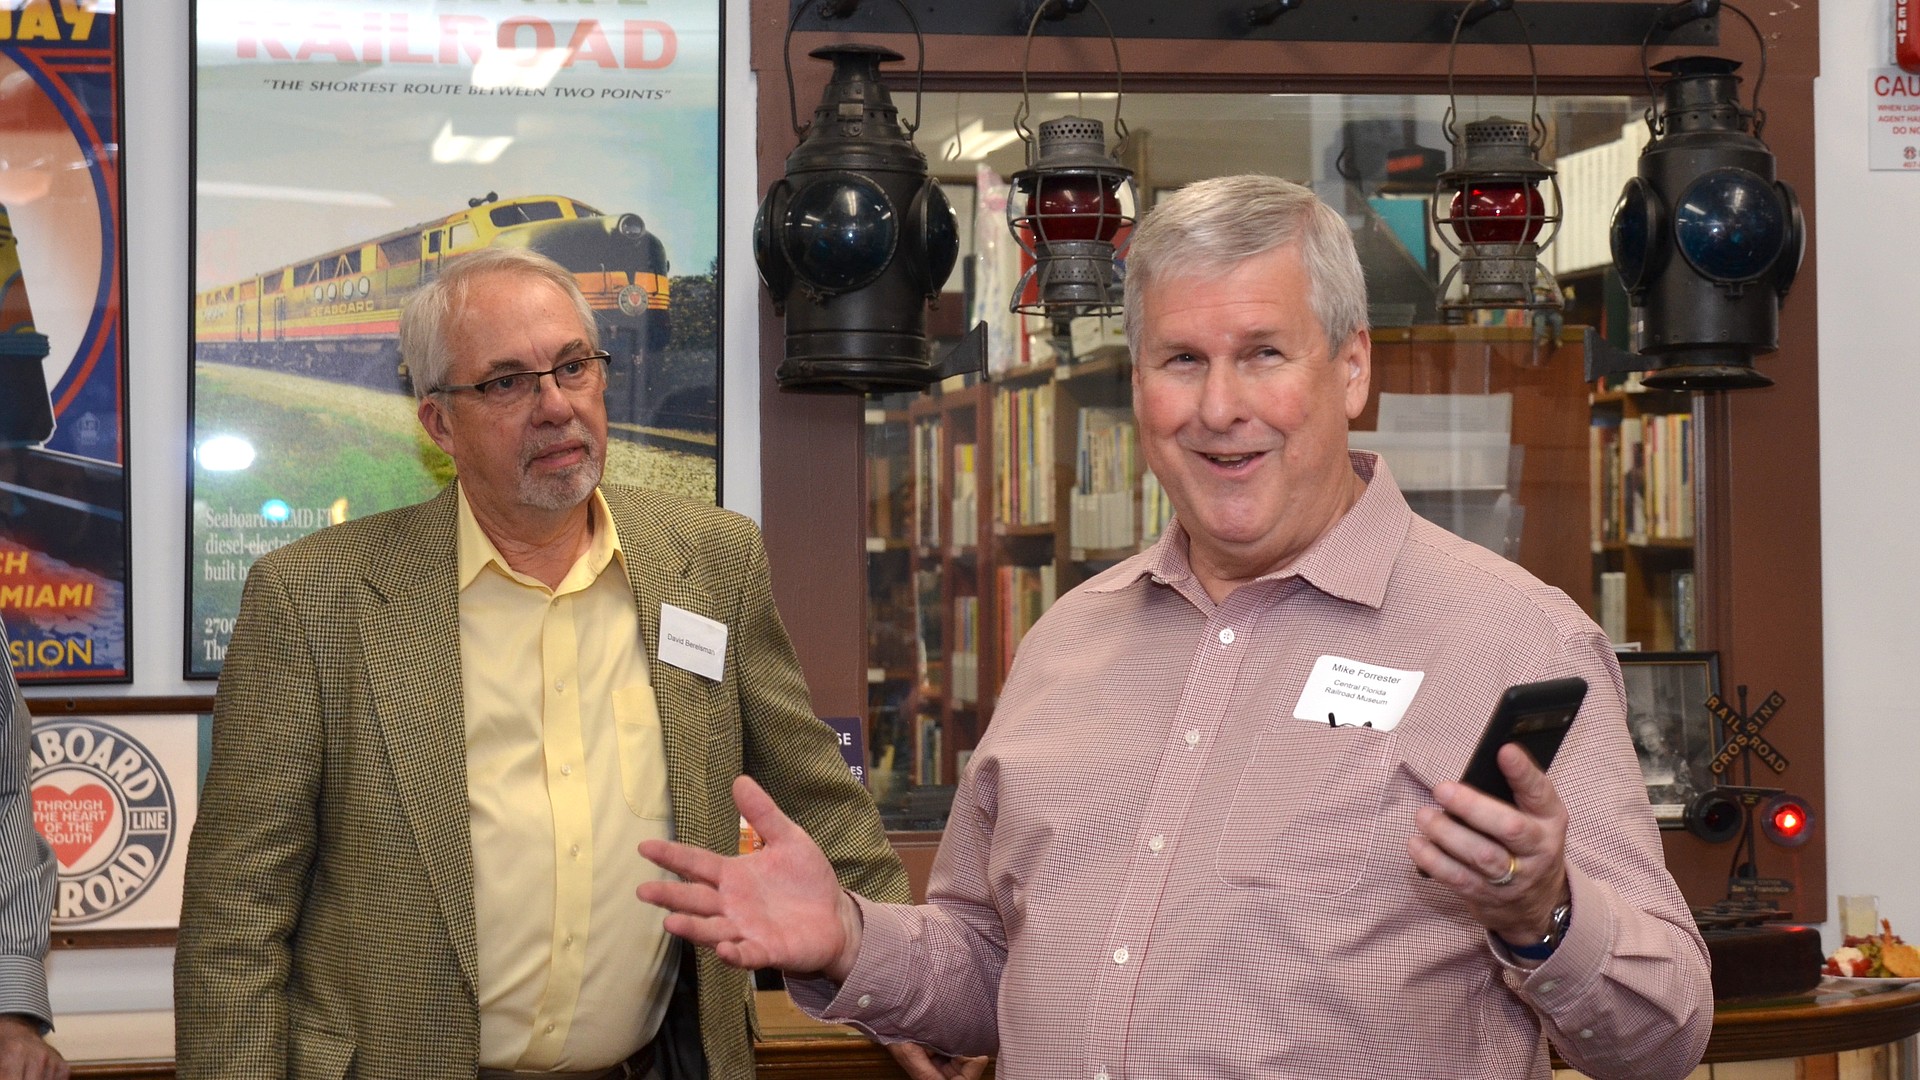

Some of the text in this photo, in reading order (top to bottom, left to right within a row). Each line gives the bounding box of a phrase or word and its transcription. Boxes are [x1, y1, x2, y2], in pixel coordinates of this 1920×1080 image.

[309, 80, 397, 93] SHORTEST
[403, 83, 463, 95] ROUTE
[553, 87, 595, 98] TWO
[1874, 75, 1920, 97] CAU
[1892, 126, 1907, 134] DO
[205, 506, 278, 528] Seaboards
[204, 560, 235, 581] built
[0, 583, 94, 609] MIAMI
[667, 633, 684, 645] David
[10, 639, 92, 667] SION
[1332, 664, 1401, 684] Mike Forrester
[1324, 687, 1388, 705] Railroad Museum
[1333, 679, 1387, 696] Central Florida
[1749, 736, 1786, 772] ROAD
[34, 799, 103, 811] THROUGH
[33, 810, 107, 822] THE HEART
[133, 811, 165, 830] LINE
[44, 821, 93, 833] OF THE
[45, 833, 93, 844] SOUTH
